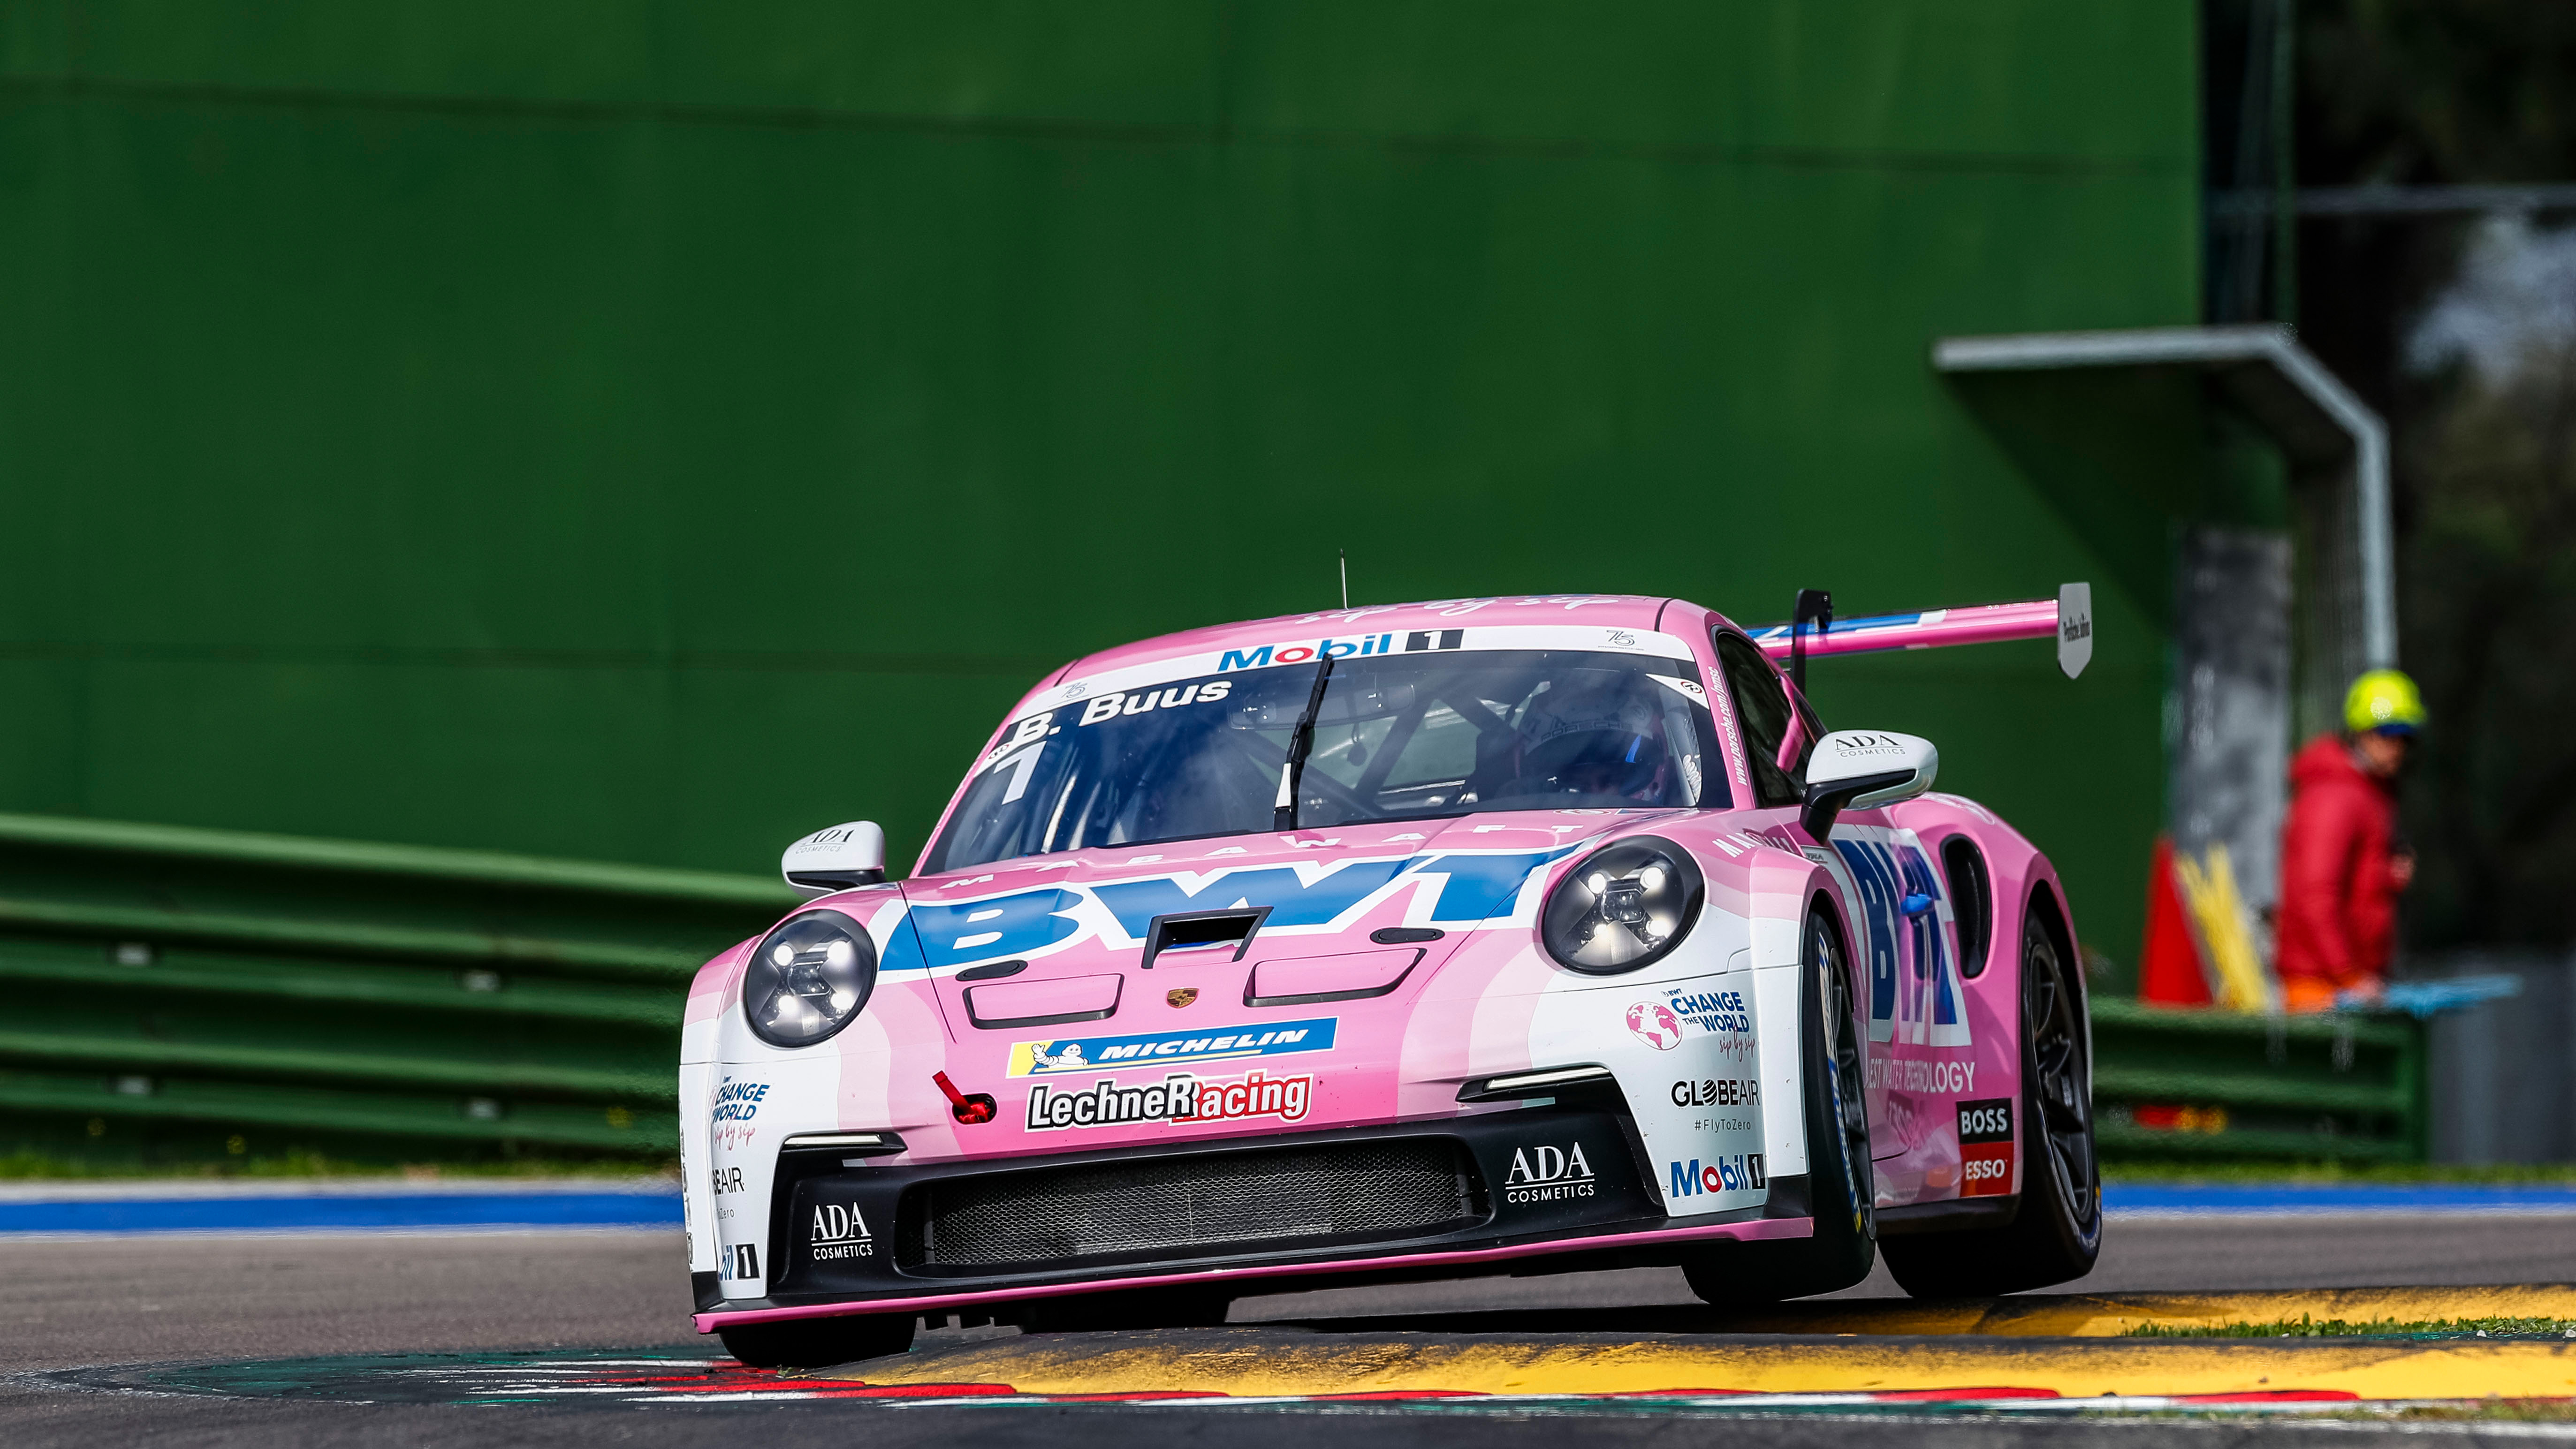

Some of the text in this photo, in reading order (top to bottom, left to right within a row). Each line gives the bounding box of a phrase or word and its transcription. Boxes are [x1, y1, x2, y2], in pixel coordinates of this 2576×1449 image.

[1217, 633, 1392, 672] Mobil
[1011, 680, 1232, 746] B. Buus
[1835, 734, 1902, 751] ADA
[1840, 748, 1906, 758] COSMETICS
[993, 740, 1047, 805] 1
[879, 842, 1583, 971] BWT
[1671, 991, 1746, 1015] CHANGE
[1682, 1014, 1750, 1032] THE WORLD
[1098, 1029, 1309, 1060] MICHELIN
[1719, 1024, 1755, 1062] sip by sip
[715, 1083, 770, 1107] CHANGE
[1694, 1119, 1751, 1133] #FlyToZero
[1961, 1108, 2008, 1135] BOSS
[1505, 1141, 1595, 1184] ADA
[1671, 1154, 1748, 1198] Mobil
[1966, 1159, 2006, 1181] ESSO
[1507, 1184, 1595, 1203] COSMETICS
[810, 1201, 872, 1241] ADA
[813, 1244, 873, 1260] COSMETICS
